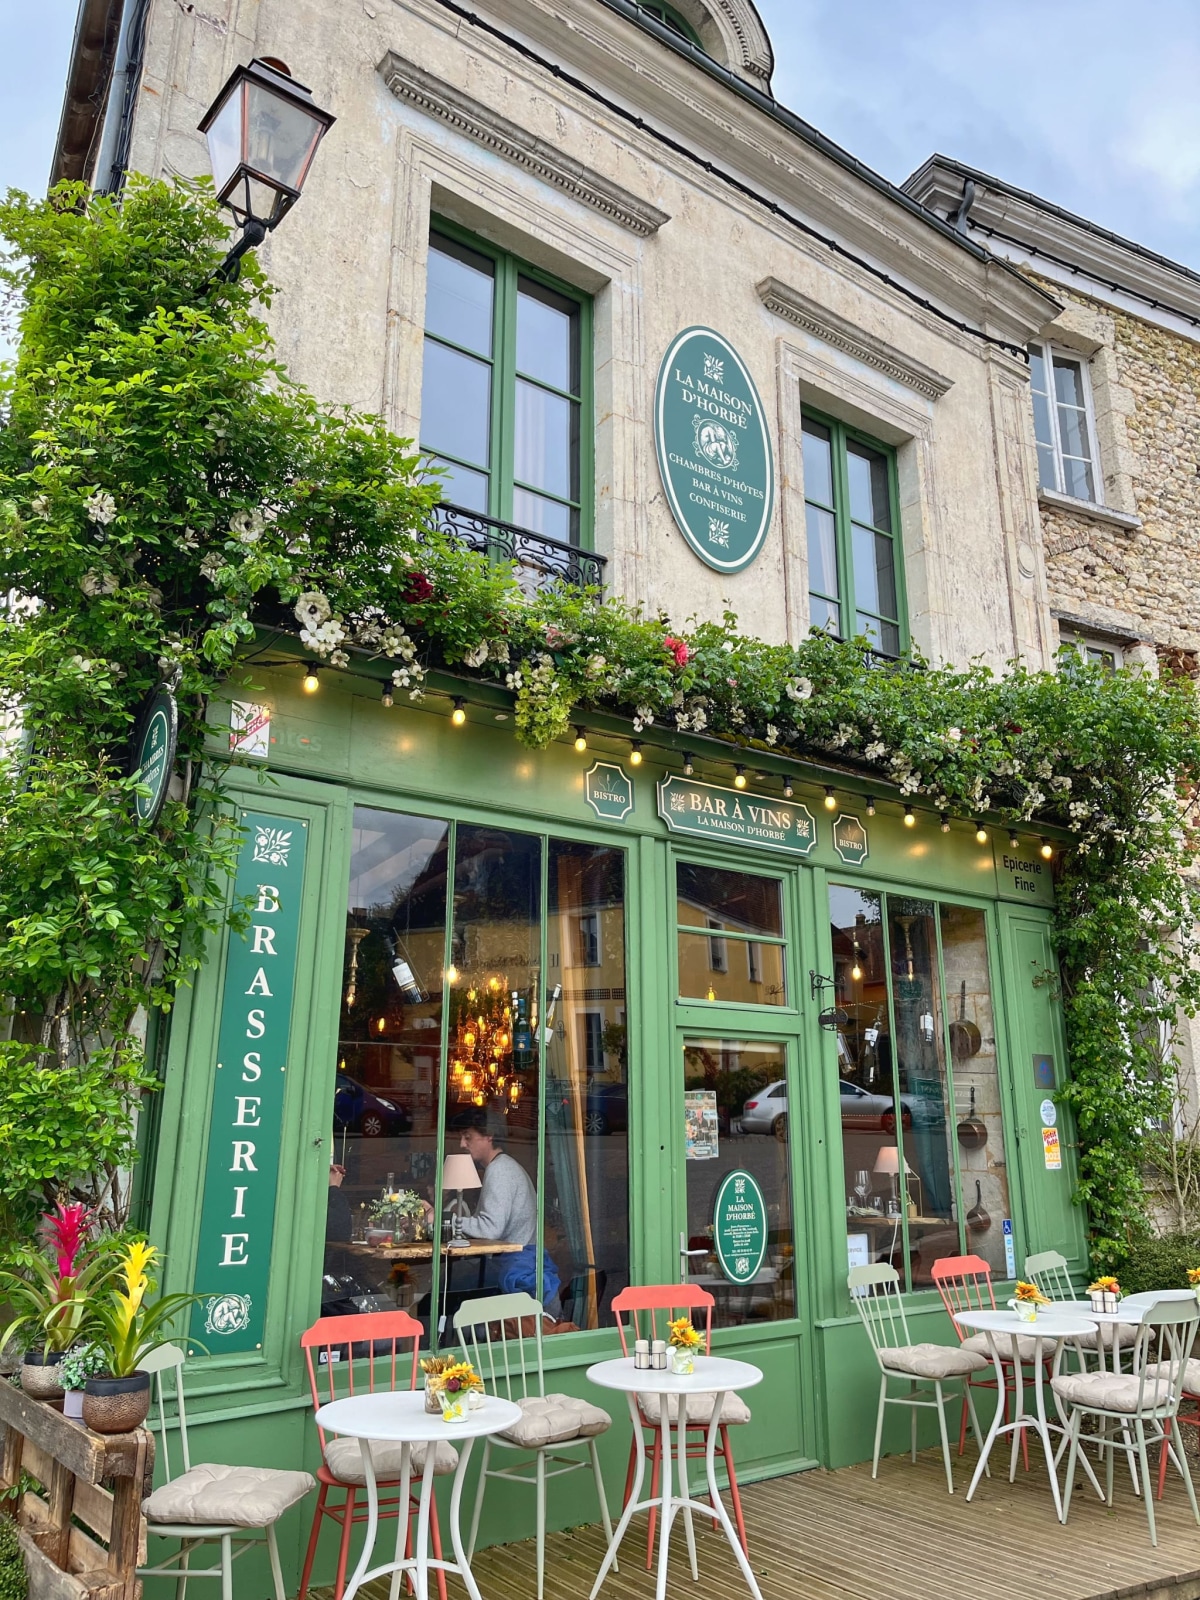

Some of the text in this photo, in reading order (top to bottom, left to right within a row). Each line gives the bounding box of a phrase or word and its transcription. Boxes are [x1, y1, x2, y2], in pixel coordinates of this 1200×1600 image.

[675, 368, 752, 416] LA MAISON
[681, 388, 748, 430] D'HORBÉ
[669, 452, 764, 500] CHAMBRES D'HÔTES
[692, 477, 744, 506] BAR À VINS
[689, 492, 747, 522] CONFISERIE
[593, 790, 626, 804] BISTRO
[689, 792, 792, 829] BAR À VINS
[697, 815, 786, 841] LA MAISON D'HORBÉ
[838, 838, 863, 851] BISTRO
[1002, 854, 1042, 874] Epicerie
[1014, 876, 1036, 892] Fine
[218, 884, 280, 1266] BRASSERIE
[726, 1211, 756, 1221] D'HORBÉ
[728, 1203, 754, 1212] MAISON
